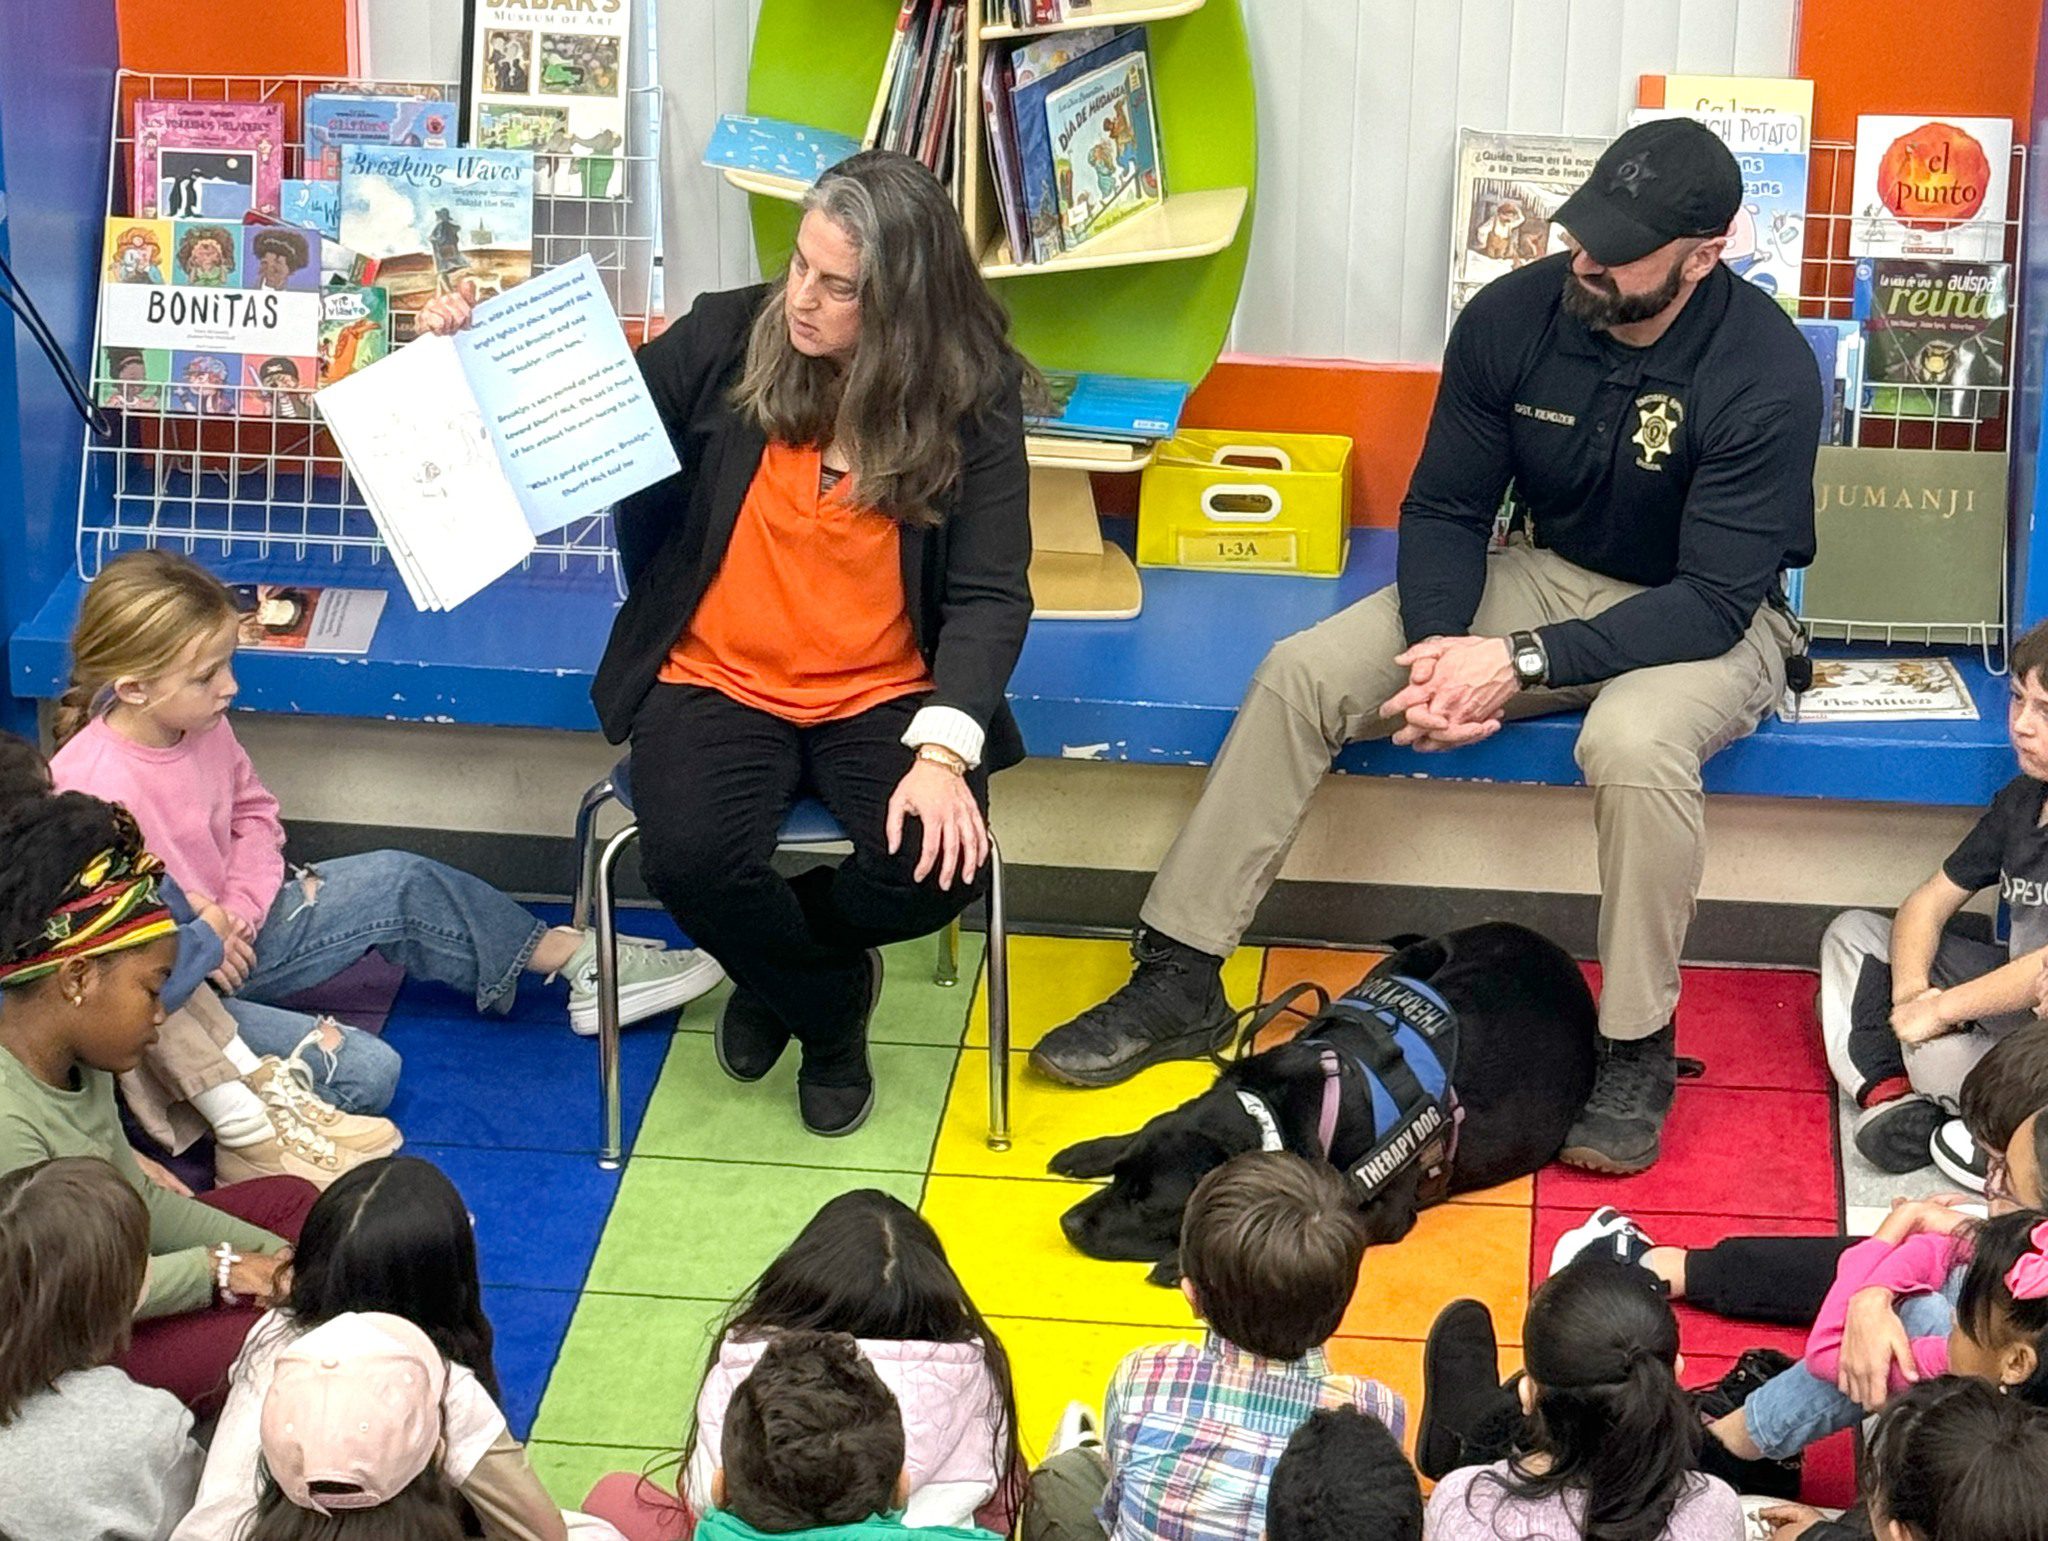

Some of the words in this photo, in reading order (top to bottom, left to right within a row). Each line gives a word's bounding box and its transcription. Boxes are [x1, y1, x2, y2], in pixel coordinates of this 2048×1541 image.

[1058, 120, 1077, 151] DÍA
[1075, 106, 1088, 130] DE
[351, 152, 448, 188] Breaking
[457, 156, 523, 181] Waves
[1928, 142, 1949, 174] el
[1895, 180, 1977, 211] punto
[1888, 279, 2004, 320] reina
[1817, 484, 1975, 518] JUMANJI
[1218, 542, 1258, 556] 1-3A
[1818, 697, 1860, 707] The
[1863, 697, 1932, 707] Mitten
[1382, 985, 1448, 1035] THERAPY
[1355, 1131, 1417, 1189] THERAPY
[1412, 1106, 1442, 1141] DOG
